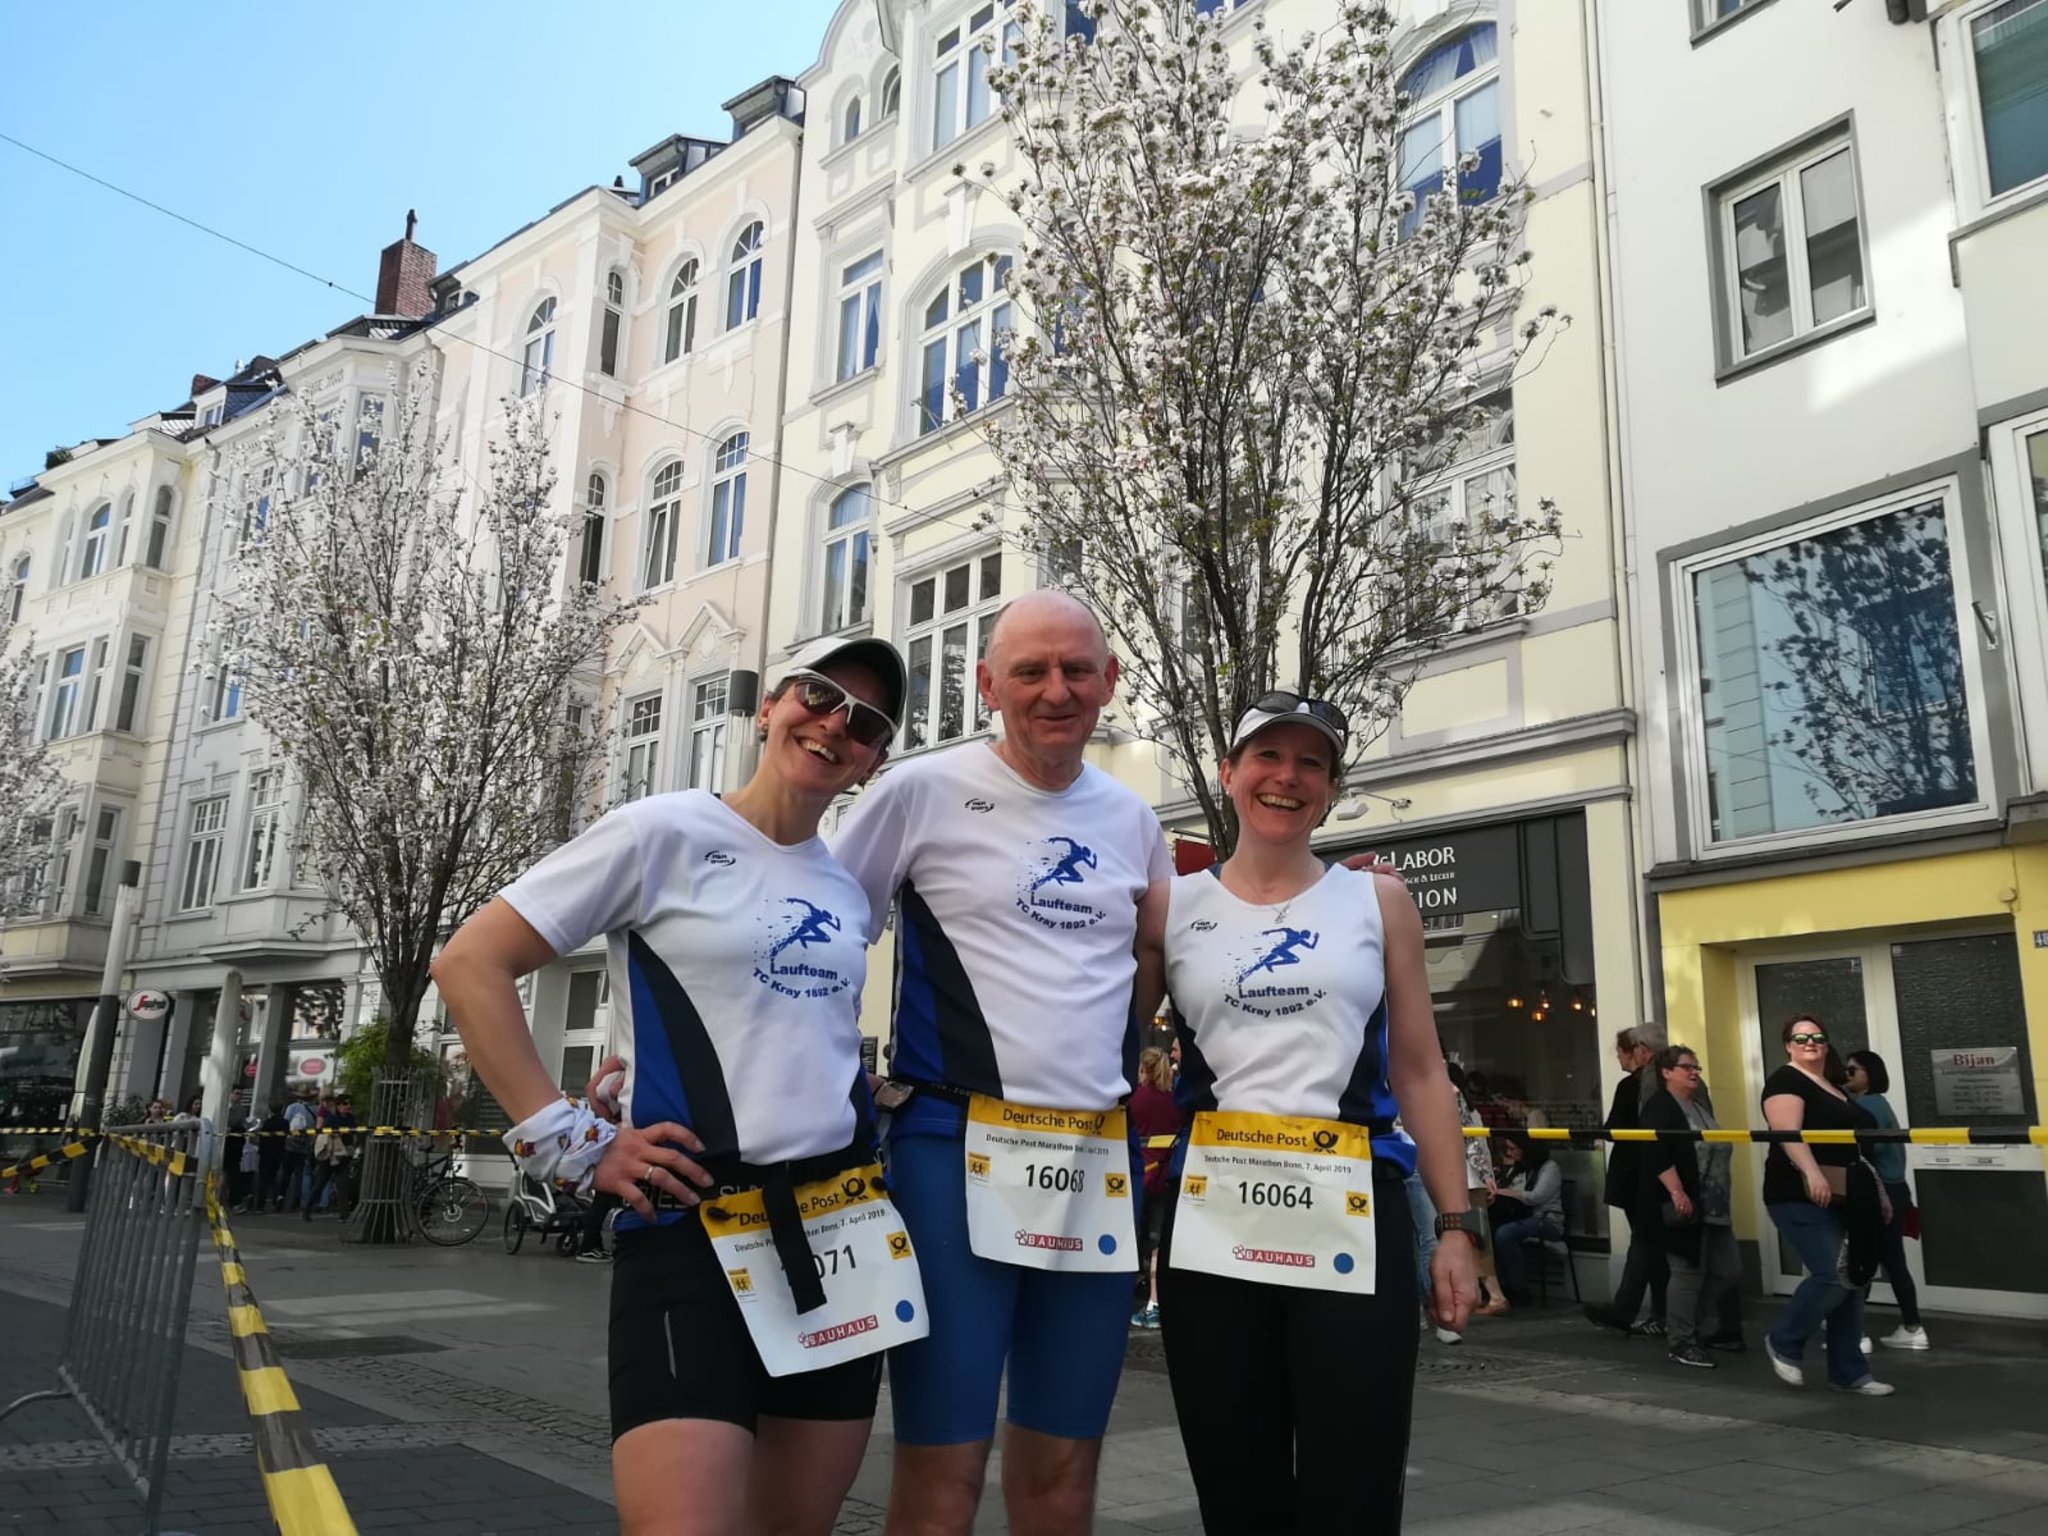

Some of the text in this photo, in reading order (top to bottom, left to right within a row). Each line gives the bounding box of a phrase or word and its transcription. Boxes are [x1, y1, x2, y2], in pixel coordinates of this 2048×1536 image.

[1373, 846, 1456, 871] LABOR
[1031, 892, 1092, 914] Laufteam
[1409, 886, 1457, 909] ION
[1016, 898, 1030, 913] TC
[1031, 910, 1057, 929] Kray
[770, 960, 838, 980] Laufteam
[753, 968, 769, 983] TC
[771, 980, 801, 999] Kray
[1239, 985, 1309, 999] Laufteam
[1225, 994, 1240, 1008] TC
[1242, 1003, 1271, 1018] Kray
[1953, 1054, 1994, 1068] Bijan
[1003, 1108, 1065, 1127] Deutsche
[986, 1133, 1018, 1146] Deutsche
[1020, 1139, 1037, 1148] Post
[1037, 1141, 1073, 1152] Marathon
[1217, 1128, 1307, 1147] Deutsche Post
[1204, 1155, 1230, 1164] Deutsche
[1232, 1157, 1247, 1166] Post
[1249, 1158, 1282, 1168] Marathon
[1314, 1164, 1332, 1173] April
[1334, 1165, 1351, 1174] 2019
[1025, 1164, 1085, 1193] 16068
[811, 1191, 840, 1211] Post
[1238, 1181, 1314, 1210] 16064
[849, 1212, 866, 1225] April
[867, 1208, 886, 1220] 2019
[734, 1239, 764, 1253] Deutsche
[1246, 1250, 1314, 1266] BAUHAUS
[809, 1316, 877, 1345] BAUHAUS
